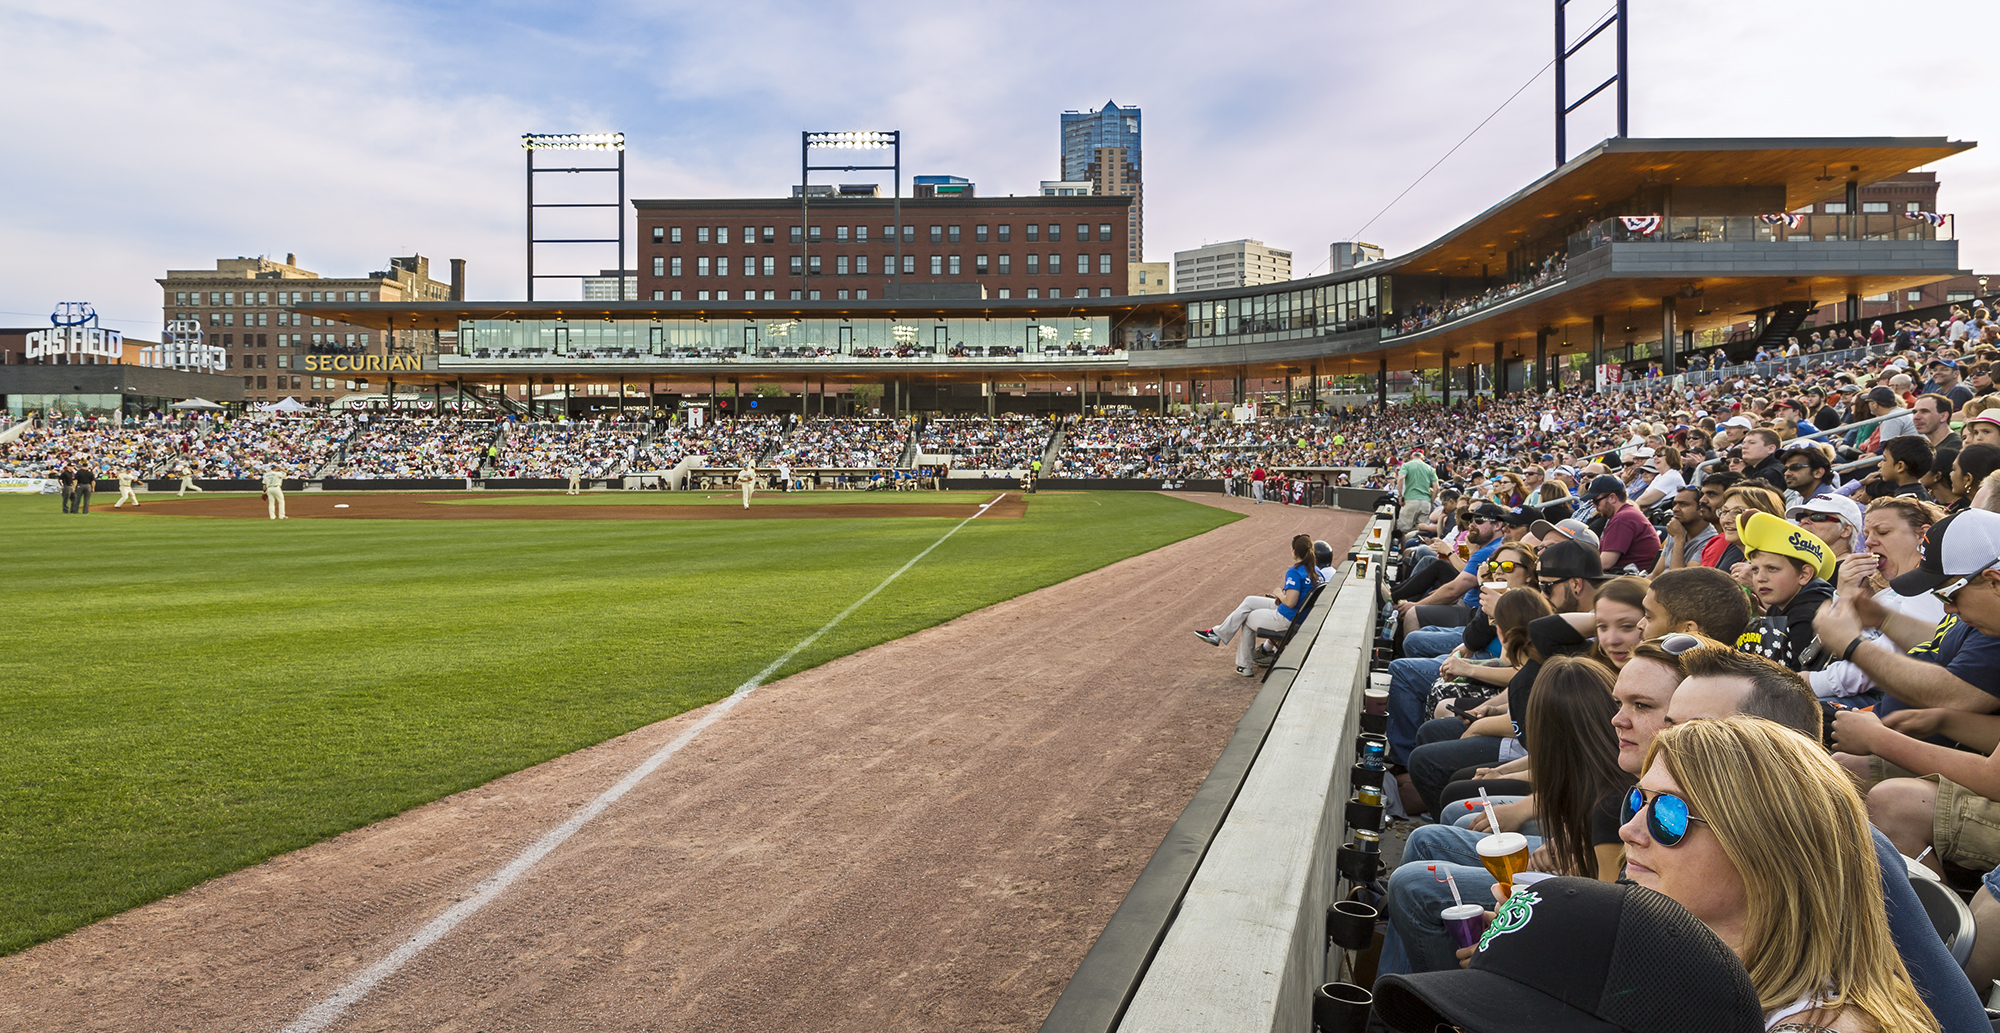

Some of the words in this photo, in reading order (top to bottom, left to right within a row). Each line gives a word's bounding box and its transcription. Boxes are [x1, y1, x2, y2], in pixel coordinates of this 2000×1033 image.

[25, 328, 66, 359] CHS
[70, 327, 123, 359] FIELD
[304, 355, 422, 371] SECURIAN
[1788, 531, 1823, 561] Saints
